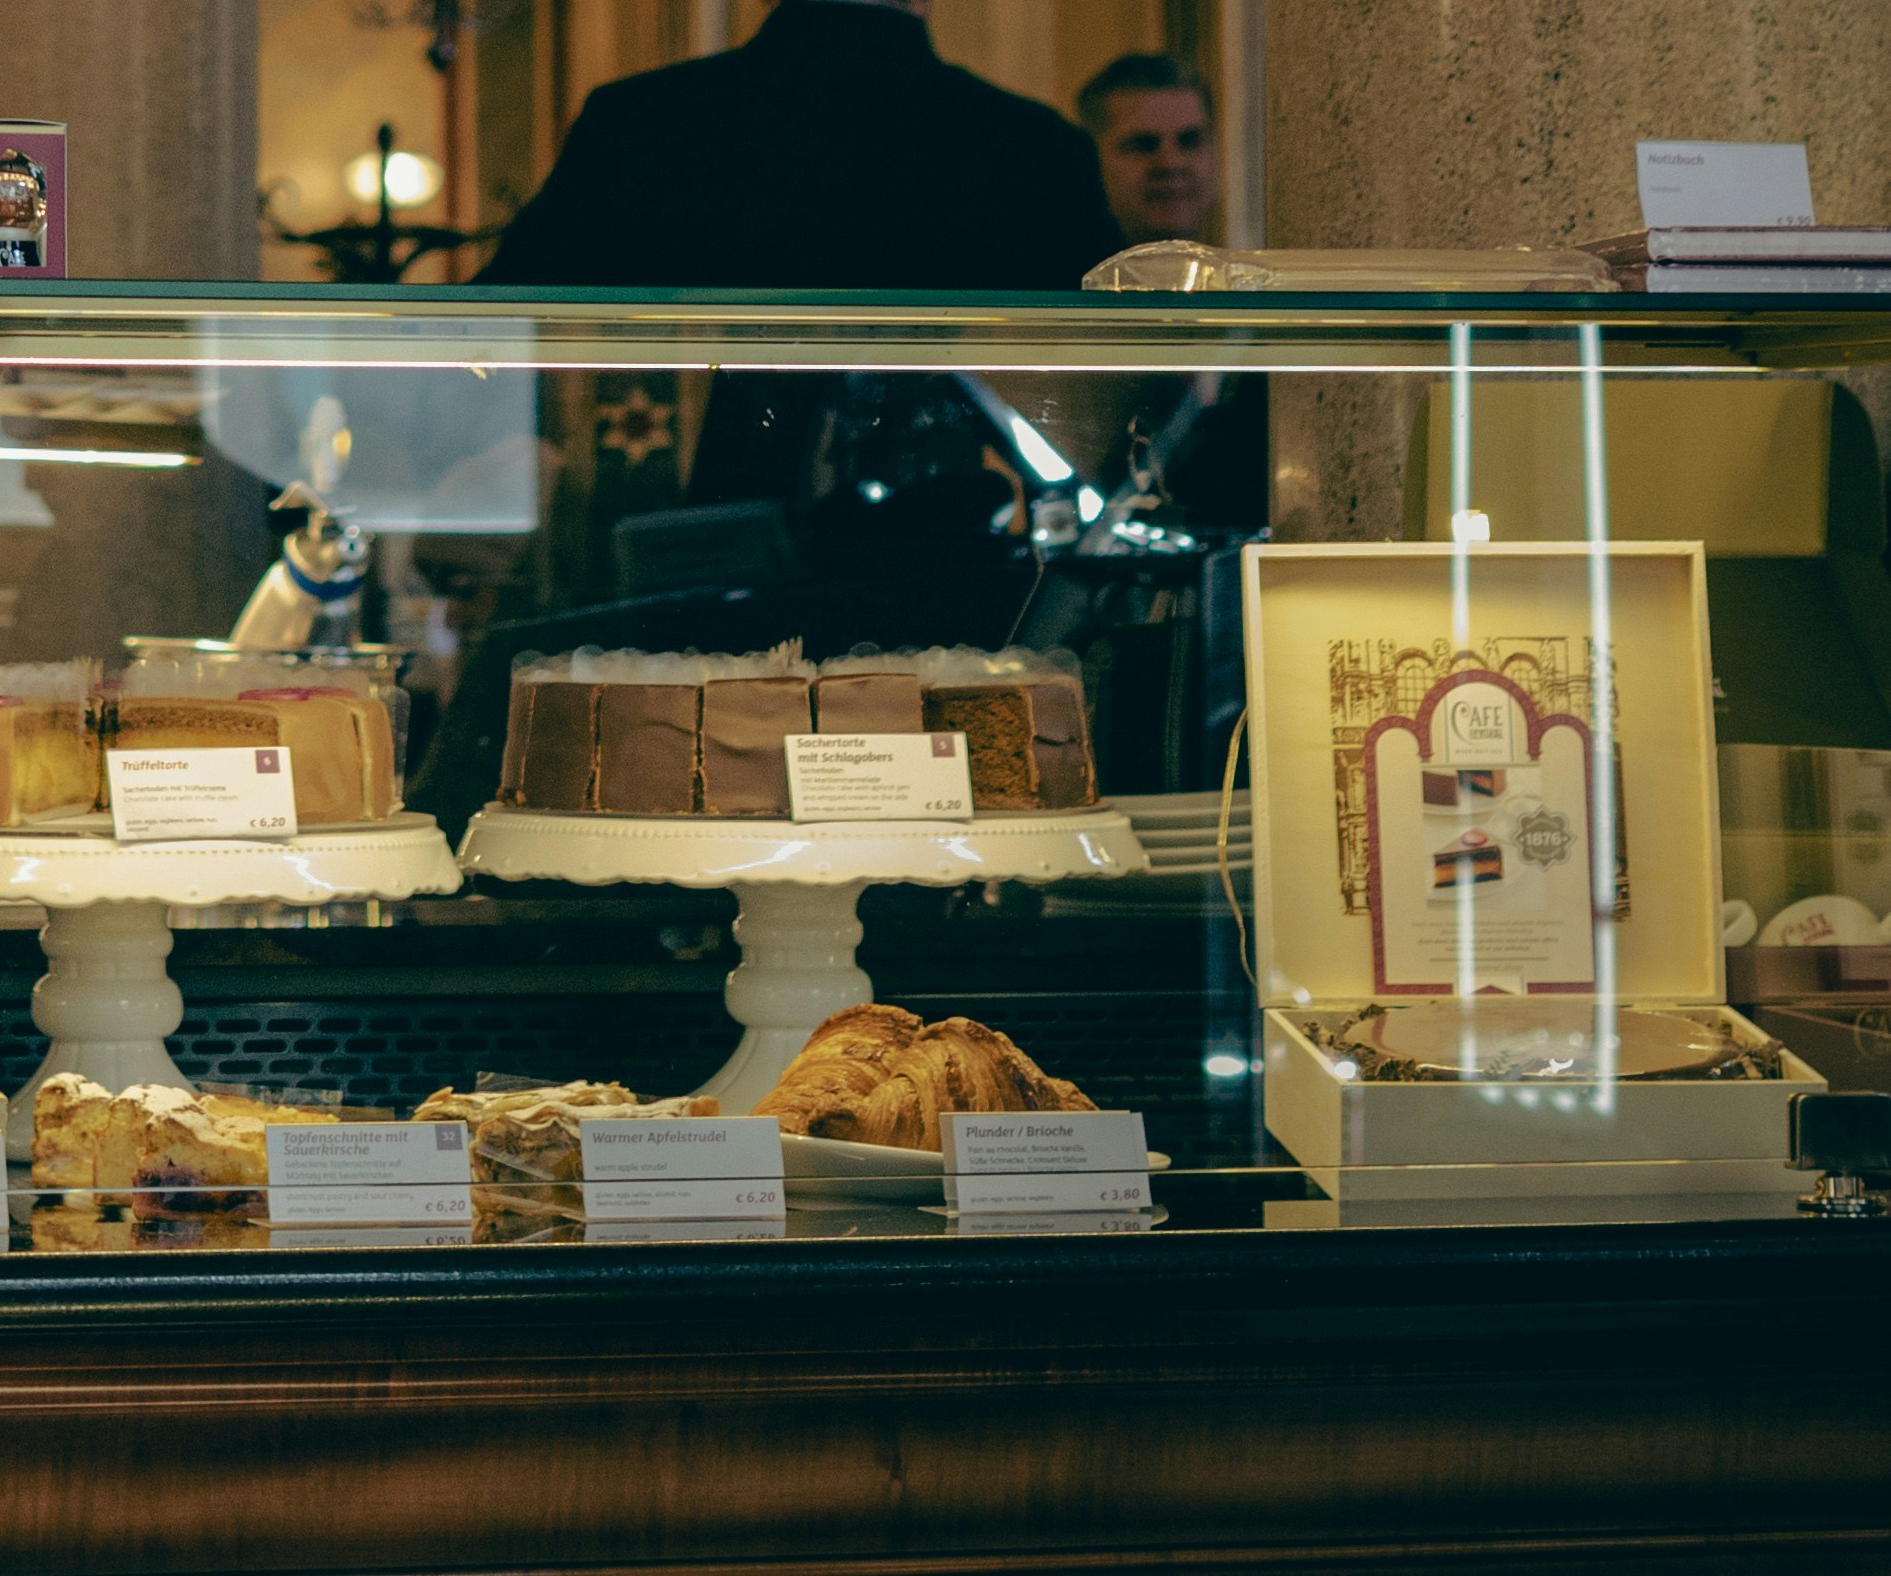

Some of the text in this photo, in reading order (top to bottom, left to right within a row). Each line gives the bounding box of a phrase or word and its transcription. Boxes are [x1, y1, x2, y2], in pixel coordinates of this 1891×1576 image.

[1647, 152, 1704, 166] Notizbuch
[1451, 700, 1503, 735] CAFE
[797, 737, 866, 748] Sachertorte
[797, 751, 893, 765] mit Schlagobers
[122, 759, 189, 772] Trüffeltorte
[935, 799, 962, 811] 6,20
[259, 817, 286, 828] 6,20
[1523, 832, 1562, 847] 1876
[283, 1130, 456, 1144] Topfenschnitte mit 32
[592, 1130, 727, 1145] Warmer Apfelstrudel
[966, 1126, 1015, 1138] Plunder
[1026, 1125, 1074, 1137] Brioche
[283, 1144, 370, 1156] Sauerkirsche
[736, 1191, 776, 1204] € 6,20
[1100, 1188, 1140, 1202] € 3,80
[425, 1200, 466, 1214] € 6,20
